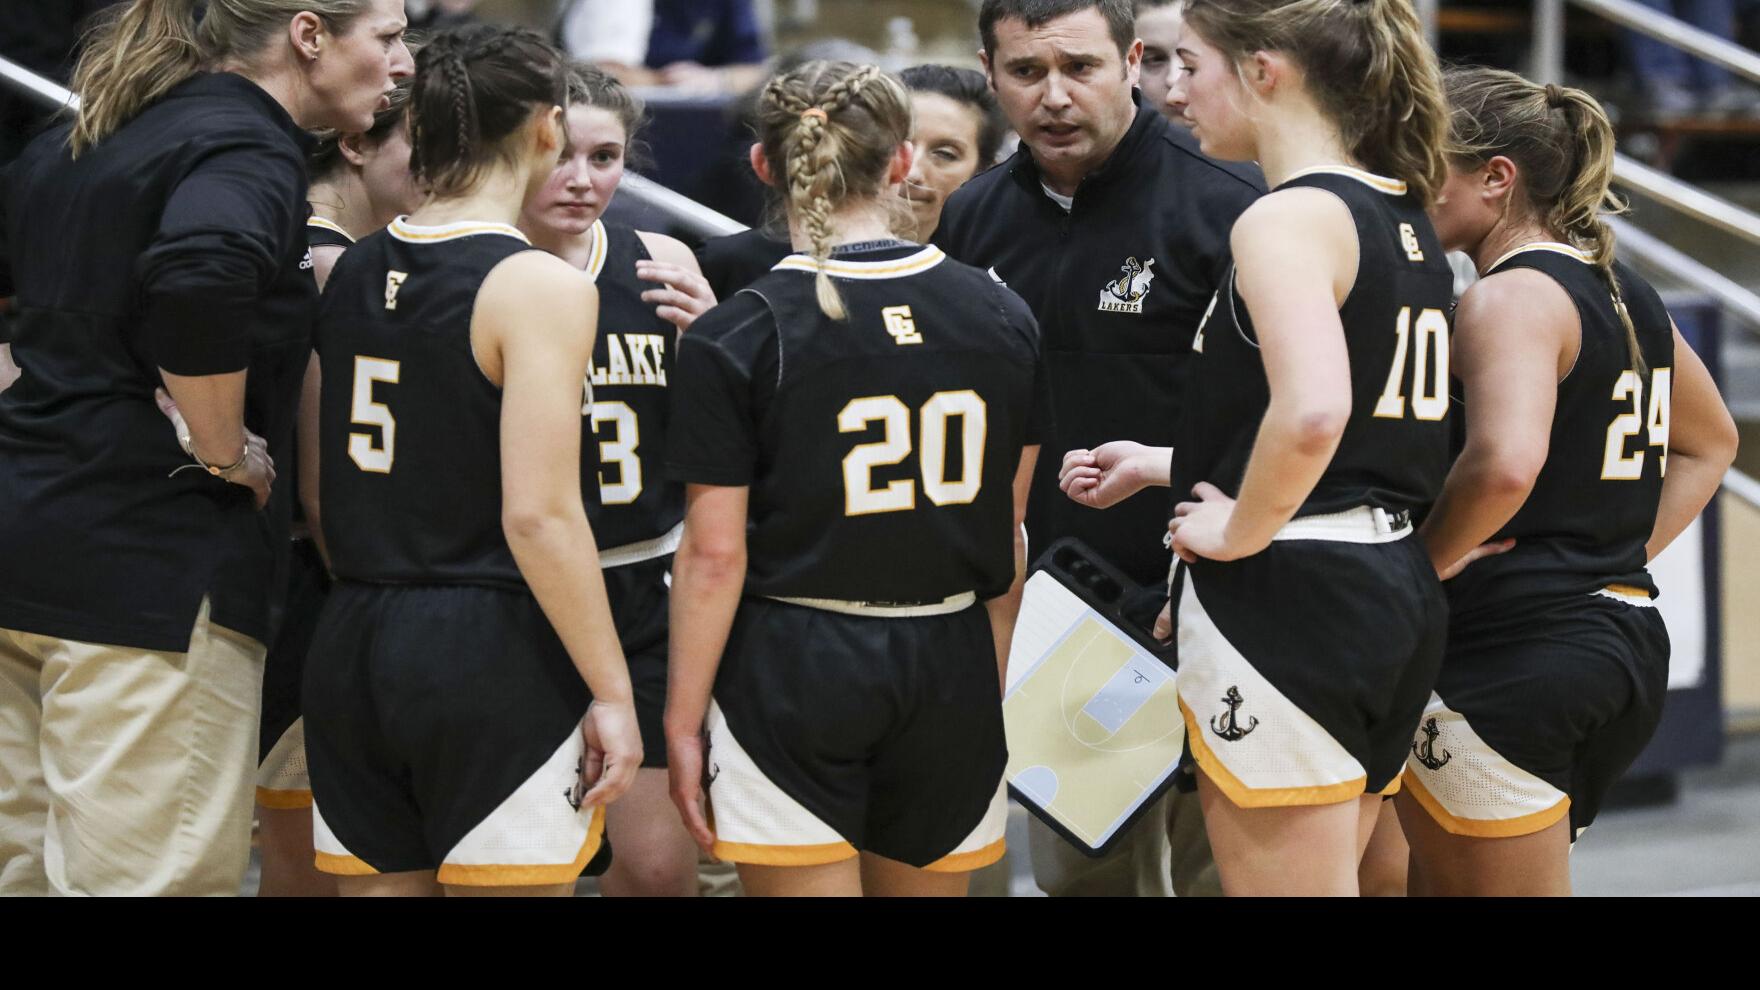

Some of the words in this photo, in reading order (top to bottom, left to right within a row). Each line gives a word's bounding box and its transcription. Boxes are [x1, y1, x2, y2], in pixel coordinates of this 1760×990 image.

[1101, 301, 1139, 312] LAKERS
[1373, 306, 1449, 421] 10
[348, 355, 400, 474] 5
[591, 401, 643, 505] 3
[837, 389, 987, 516] 20
[1600, 367, 1671, 480] 24
